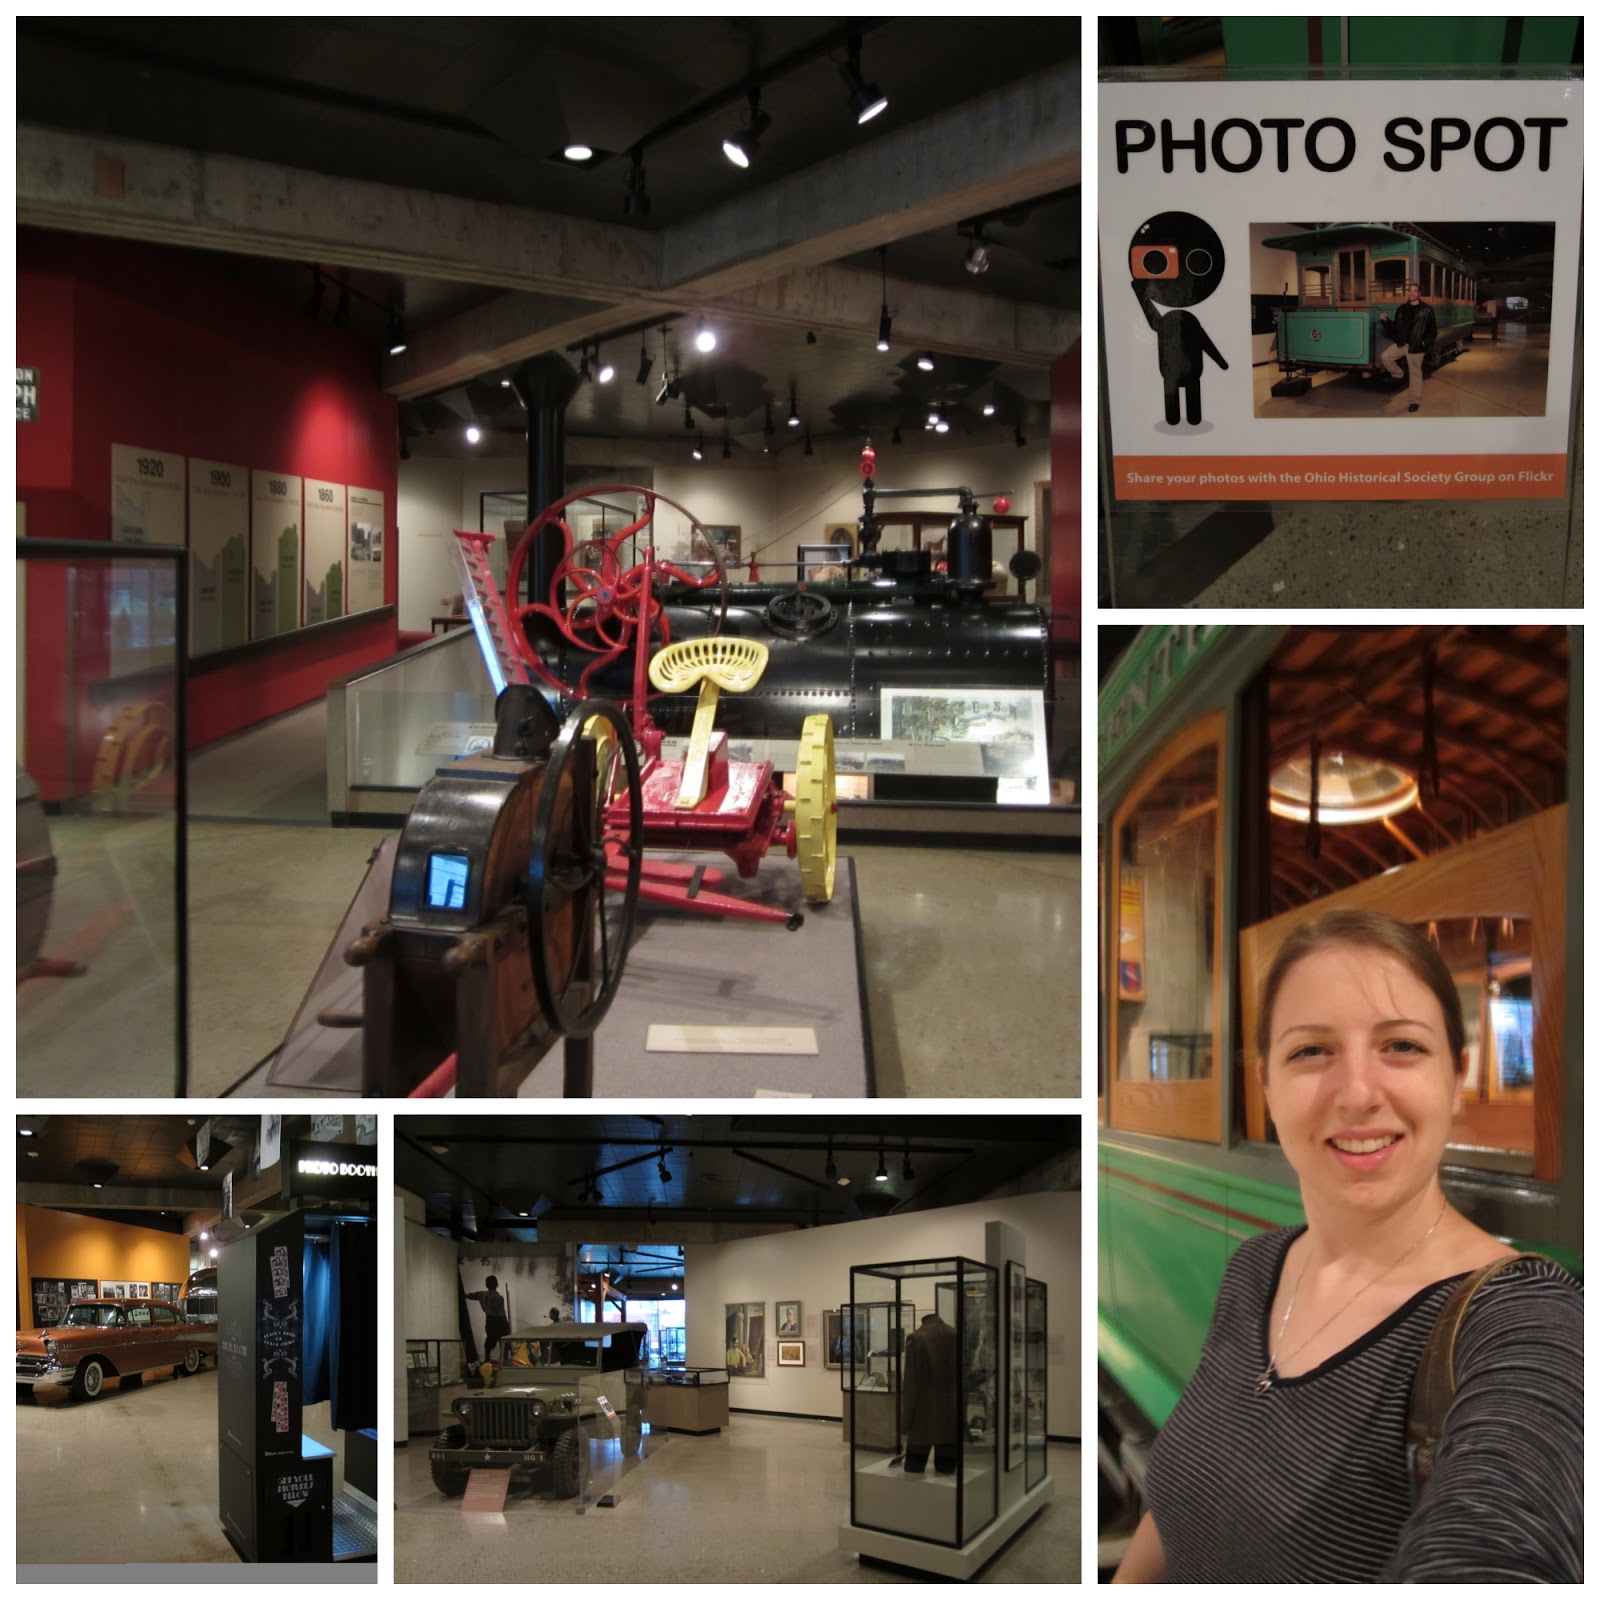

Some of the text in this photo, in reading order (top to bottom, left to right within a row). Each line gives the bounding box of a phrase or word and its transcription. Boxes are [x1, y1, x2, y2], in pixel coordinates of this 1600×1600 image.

[1115, 116, 1568, 174] PHOTO SPOT
[136, 457, 164, 477] 1920
[209, 469, 232, 487] 1900
[1127, 470, 1554, 486] Share your photos with the Ohio Historical Society Group on Flickr
[269, 479, 287, 496] 1880
[318, 488, 334, 503] 1860
[298, 1160, 339, 1175] PHOTO
